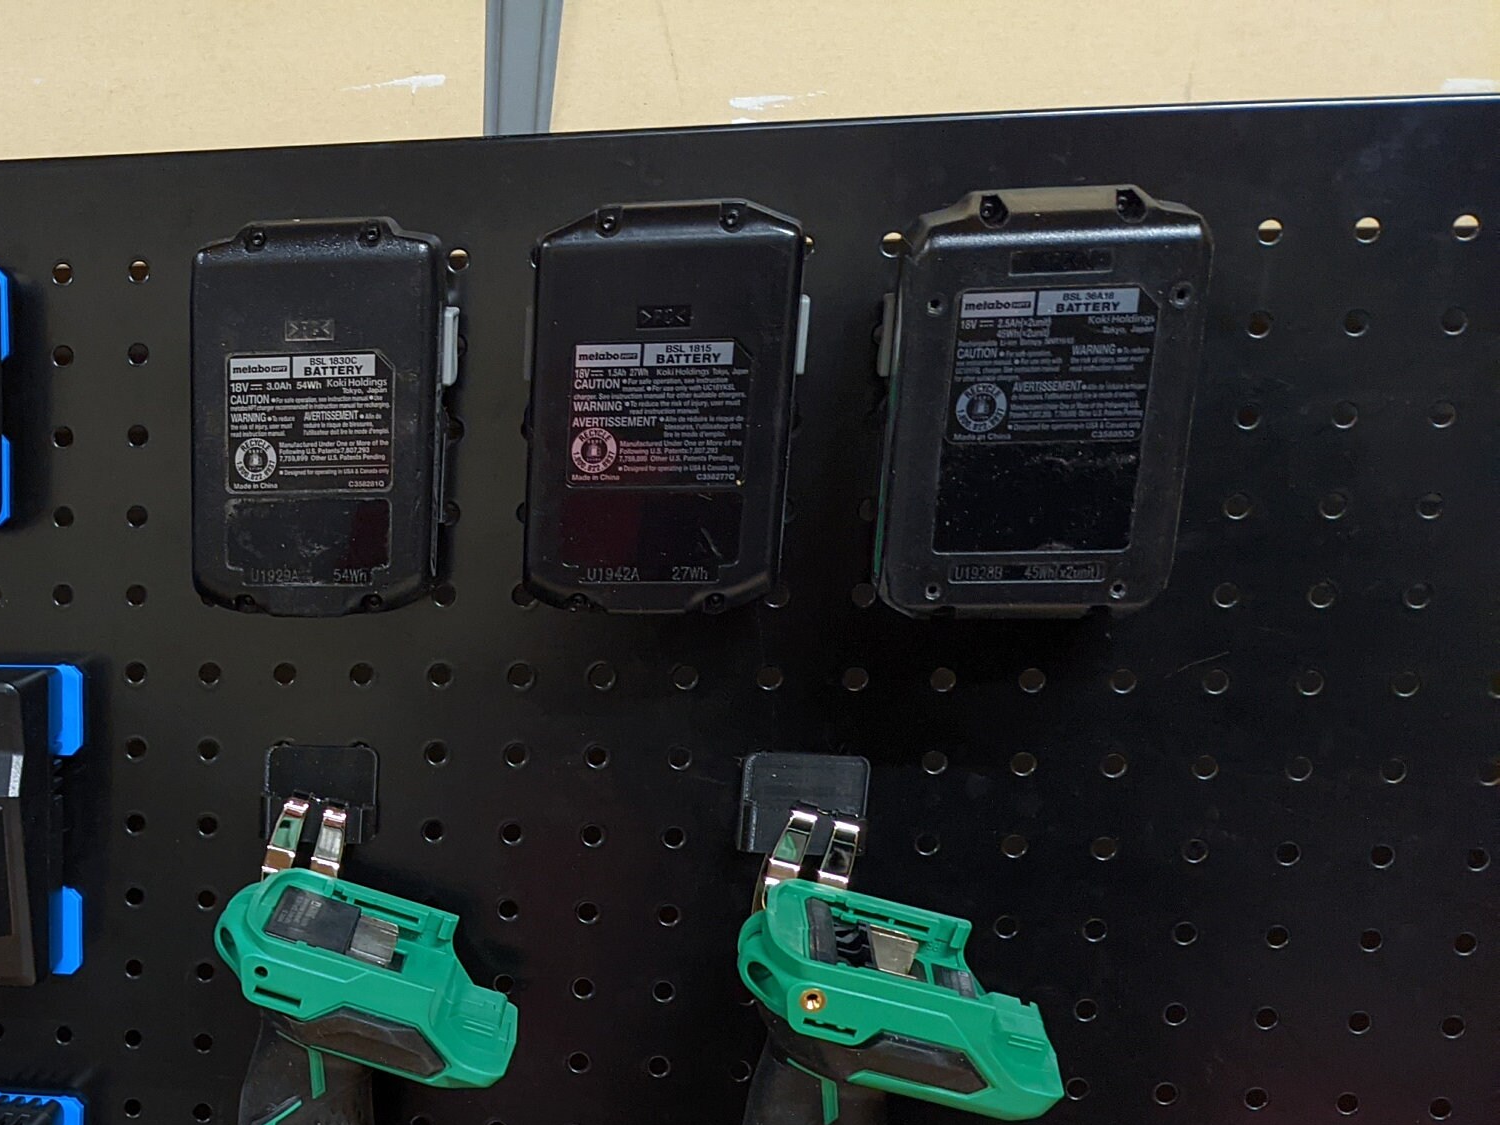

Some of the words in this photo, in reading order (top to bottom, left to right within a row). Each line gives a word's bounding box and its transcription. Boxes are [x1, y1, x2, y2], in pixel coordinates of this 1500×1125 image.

[1063, 293, 1082, 301] BSL
[1056, 302, 1122, 313] BATTERY
[1111, 314, 1156, 325] Holdings
[666, 345, 685, 353] BSL
[689, 344, 712, 352] 1815
[957, 347, 998, 359] CAUTION
[1071, 344, 1116, 356] WARNING
[310, 358, 326, 366] BSL
[329, 357, 357, 365] 1830C
[579, 352, 619, 361] metabo
[656, 353, 721, 364] BATTERY
[233, 364, 270, 374] metabo
[304, 365, 363, 377] BATTERY
[575, 368, 590, 378] 18V
[656, 368, 675, 376] Koki
[675, 367, 709, 378] Holdings
[230, 382, 249, 392] 18V
[266, 381, 292, 391] 3.0Ah
[296, 380, 322, 390] 54Wh
[327, 378, 347, 388] Koki
[348, 377, 387, 388] Holdings
[574, 379, 621, 390] CAUTION
[1012, 380, 1082, 392] AVERTISSEMENT
[230, 394, 270, 405] CAUTION
[573, 401, 623, 412] WARNING
[230, 412, 267, 423] WARNING
[303, 410, 359, 421] AVERTISSEMENT
[572, 416, 657, 427] AVERTISSEMENT
[333, 567, 367, 582] 54Wh
[587, 567, 640, 581] U1942A
[671, 566, 708, 580] 27Wh
